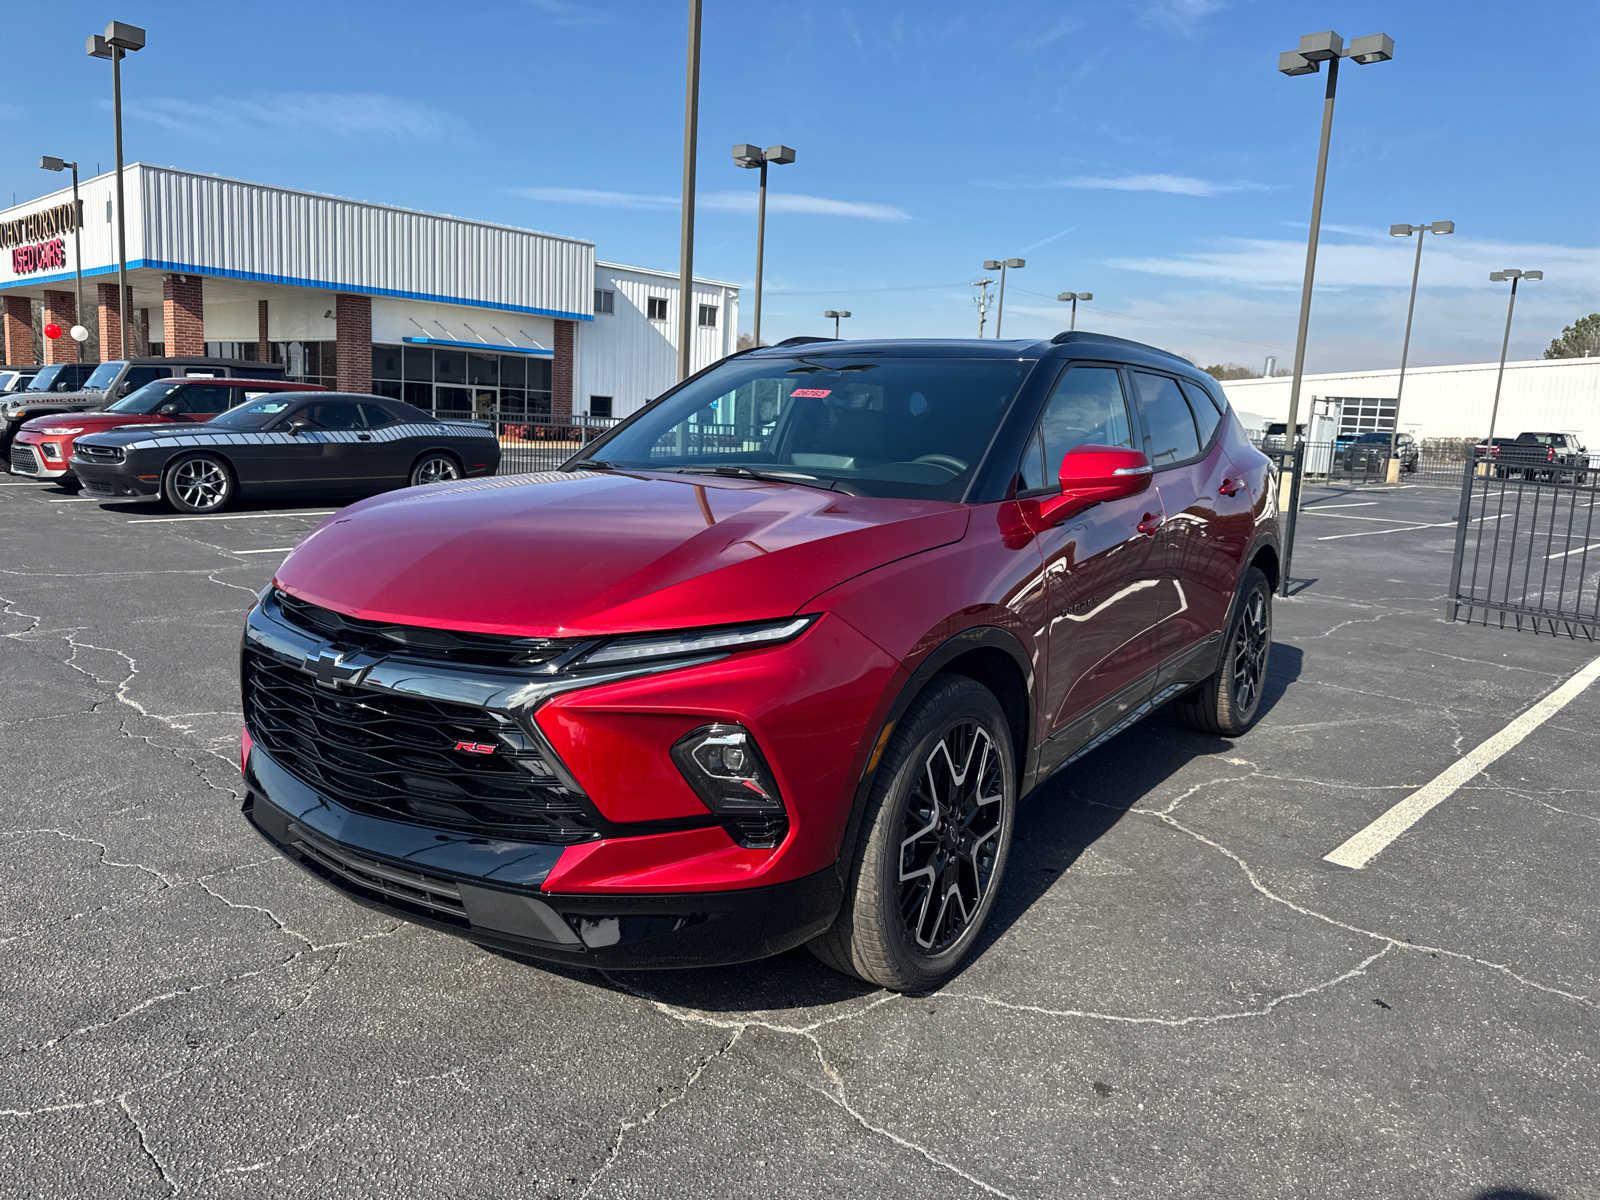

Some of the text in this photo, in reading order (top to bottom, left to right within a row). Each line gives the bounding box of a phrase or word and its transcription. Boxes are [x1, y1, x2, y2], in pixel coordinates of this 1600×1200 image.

[12, 238, 63, 273] USED CARS
[454, 741, 496, 754] RS
